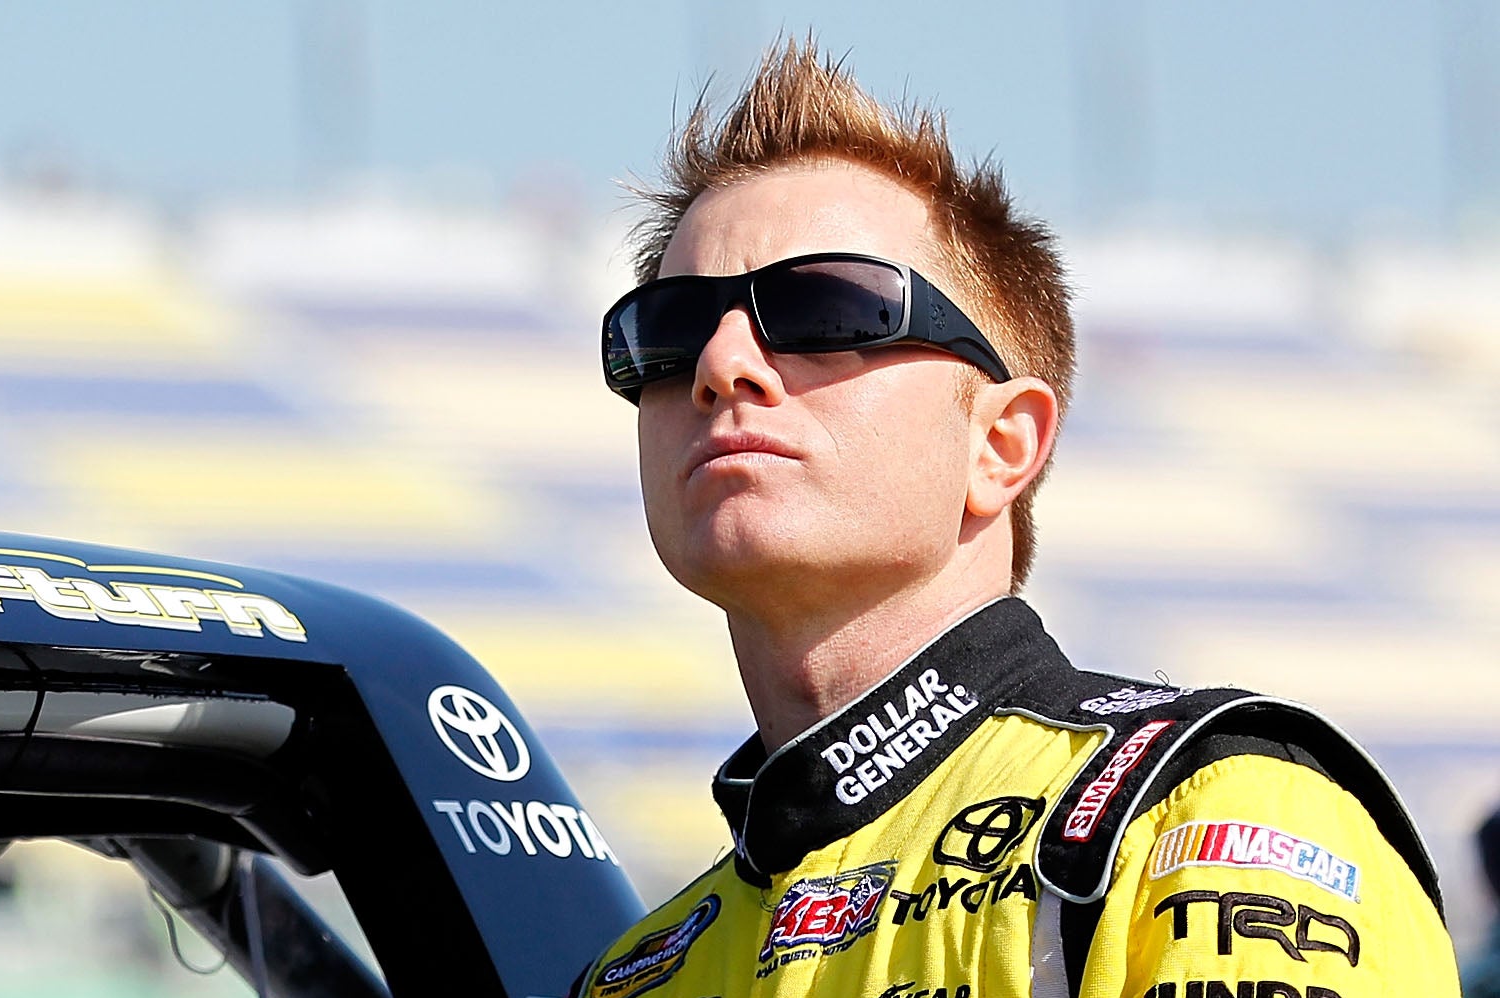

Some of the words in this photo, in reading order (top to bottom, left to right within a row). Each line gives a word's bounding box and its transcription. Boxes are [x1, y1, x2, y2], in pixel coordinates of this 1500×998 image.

[820, 668, 949, 774] DOLLAR
[835, 692, 980, 805] GENERAL
[1068, 724, 1162, 832] SIMPSON
[432, 800, 620, 867] TOYOTA
[1221, 824, 1357, 897] NASCAR
[760, 887, 886, 960] KBM
[890, 864, 1037, 925] TOYOTA
[1153, 889, 1361, 968] TRD
